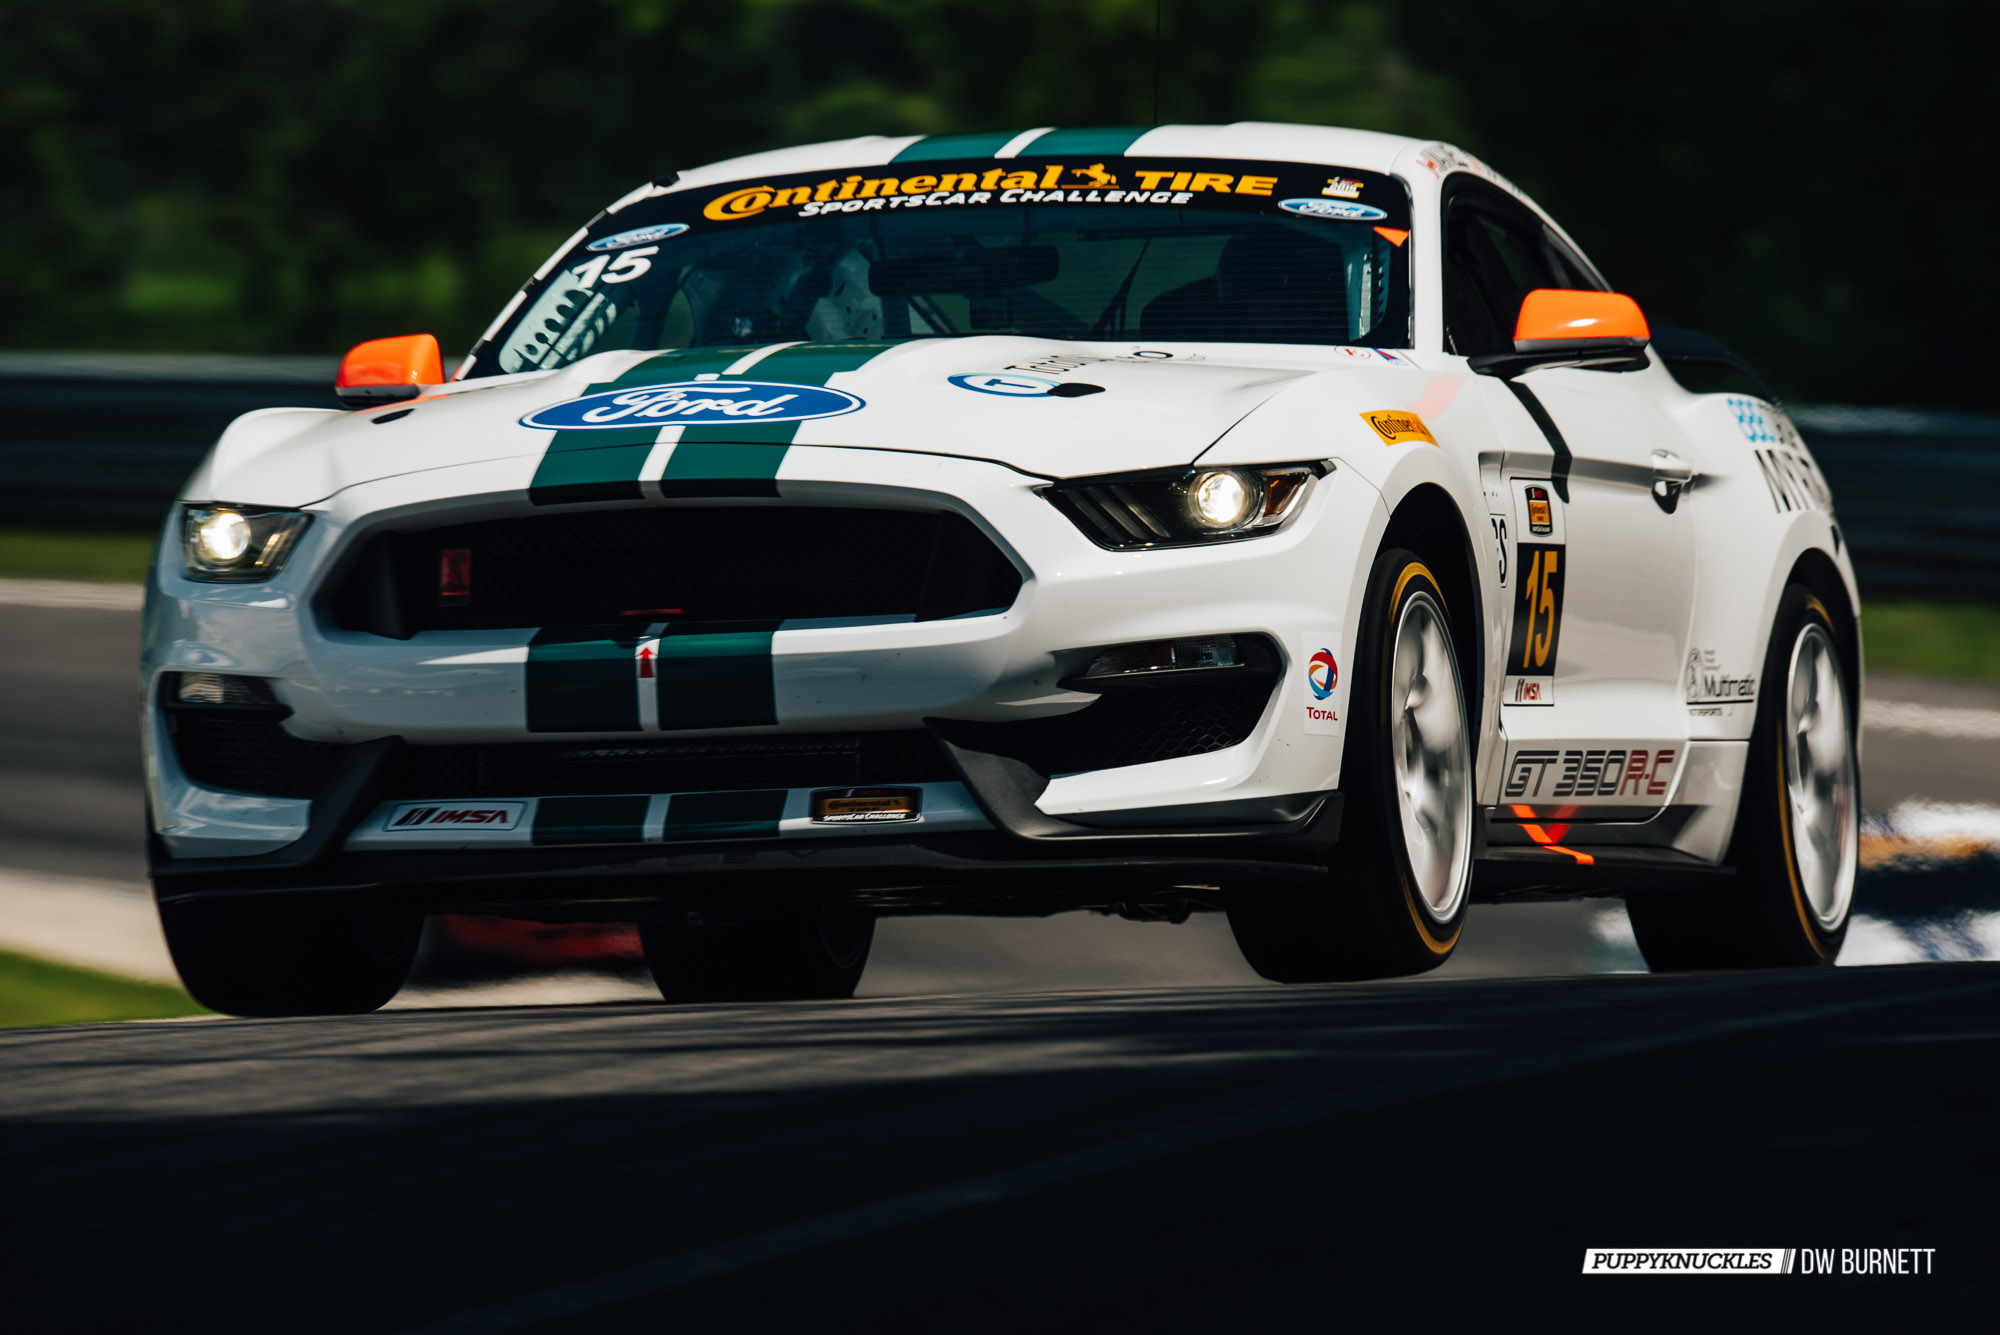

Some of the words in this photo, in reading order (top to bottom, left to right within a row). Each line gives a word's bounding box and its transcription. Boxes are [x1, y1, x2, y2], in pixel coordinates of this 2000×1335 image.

[703, 165, 1064, 221] Continental
[1133, 170, 1279, 197] TIRE
[799, 190, 990, 218] SPORTSCAR
[999, 188, 1193, 205] CHALLENGE
[572, 246, 660, 289] 15
[581, 387, 800, 423] Ford
[1522, 550, 1558, 669] 15
[1306, 706, 1339, 721] TOTAL
[428, 809, 509, 824] IMSA
